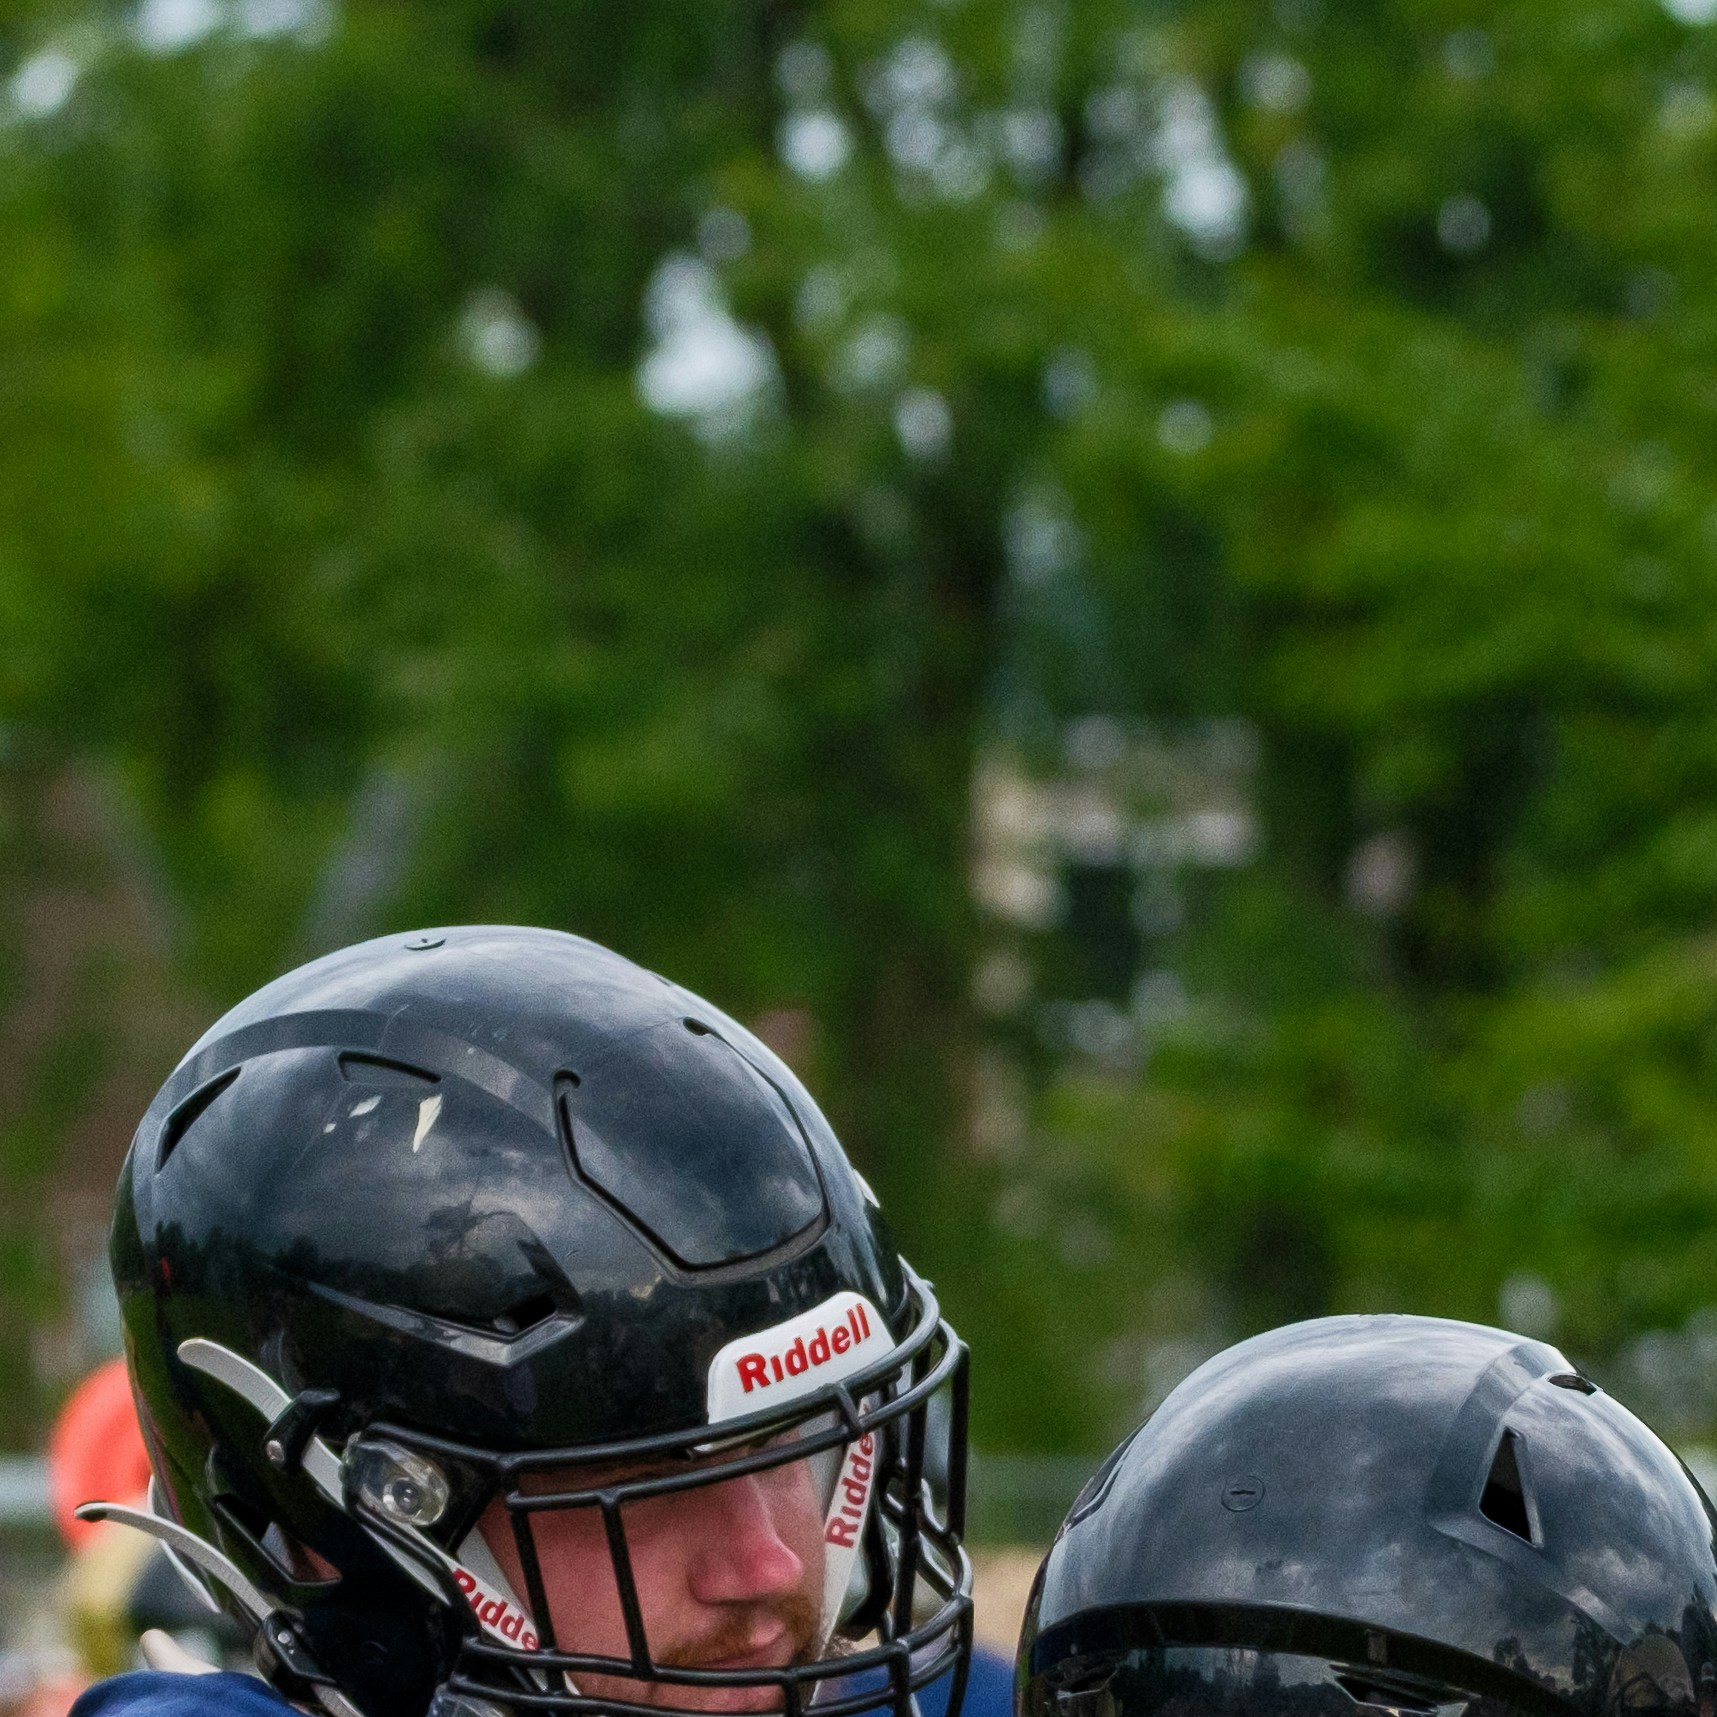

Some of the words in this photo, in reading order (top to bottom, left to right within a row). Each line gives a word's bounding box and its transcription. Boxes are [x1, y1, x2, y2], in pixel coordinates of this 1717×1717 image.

[736, 1303, 871, 1392] Riddell
[826, 1402, 876, 1549] Ridde
[453, 1567, 540, 1650] Ridde
